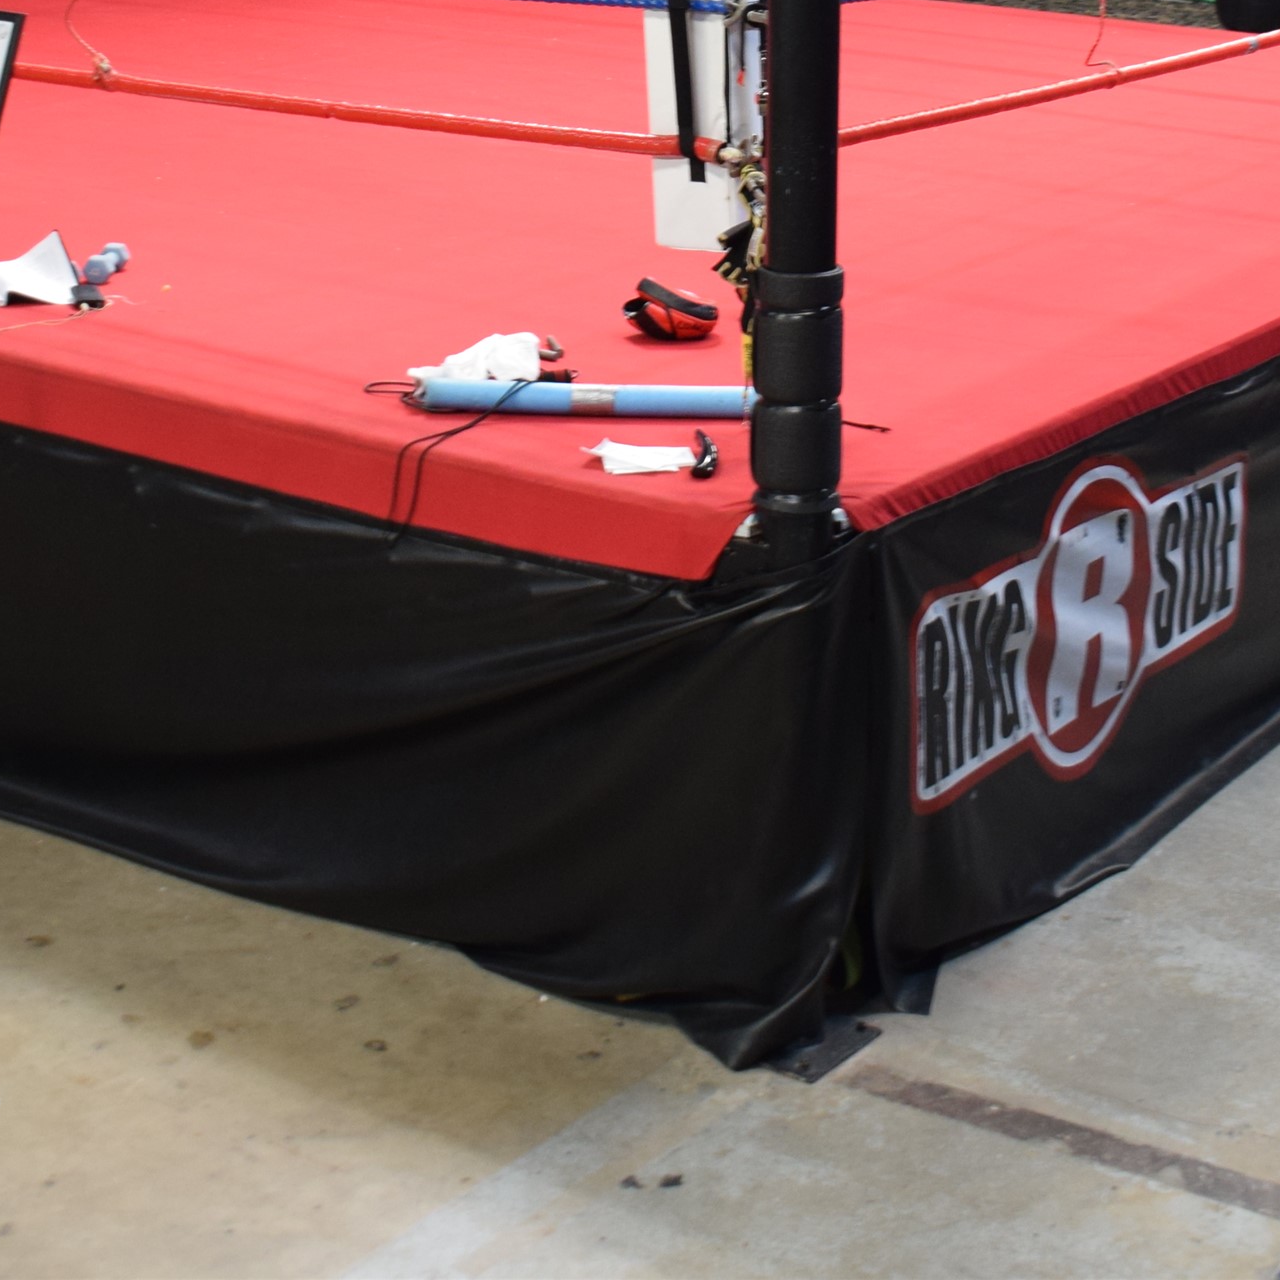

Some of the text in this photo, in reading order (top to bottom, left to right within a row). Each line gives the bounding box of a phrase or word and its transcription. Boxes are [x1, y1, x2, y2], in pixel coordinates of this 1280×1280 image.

[923, 469, 1238, 790] RING R SIDE
